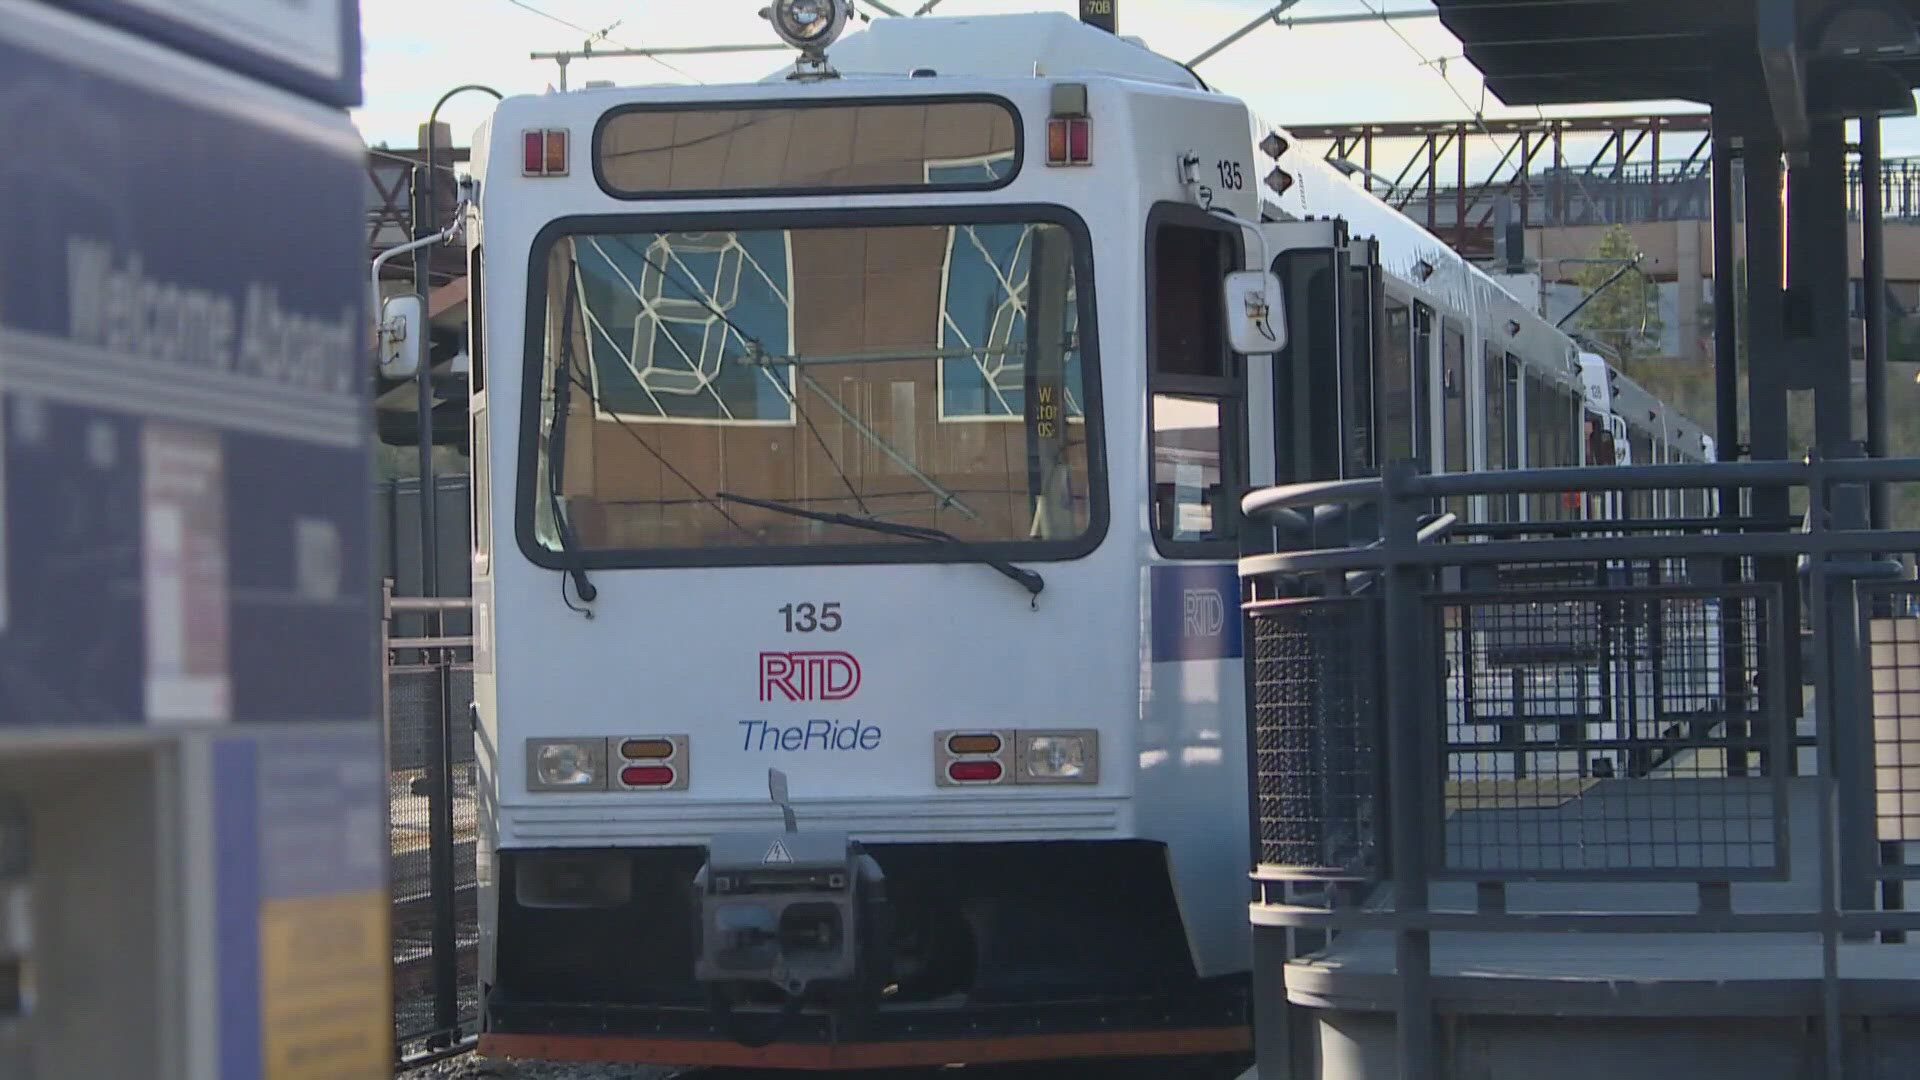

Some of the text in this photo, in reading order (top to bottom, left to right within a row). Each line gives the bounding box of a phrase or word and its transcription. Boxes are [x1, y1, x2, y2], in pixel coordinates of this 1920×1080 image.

[1217, 160, 1242, 190] 135
[778, 602, 843, 633] 135
[1183, 589, 1224, 637] RTD
[759, 651, 862, 702] RTD
[738, 719, 882, 751] TheRide
